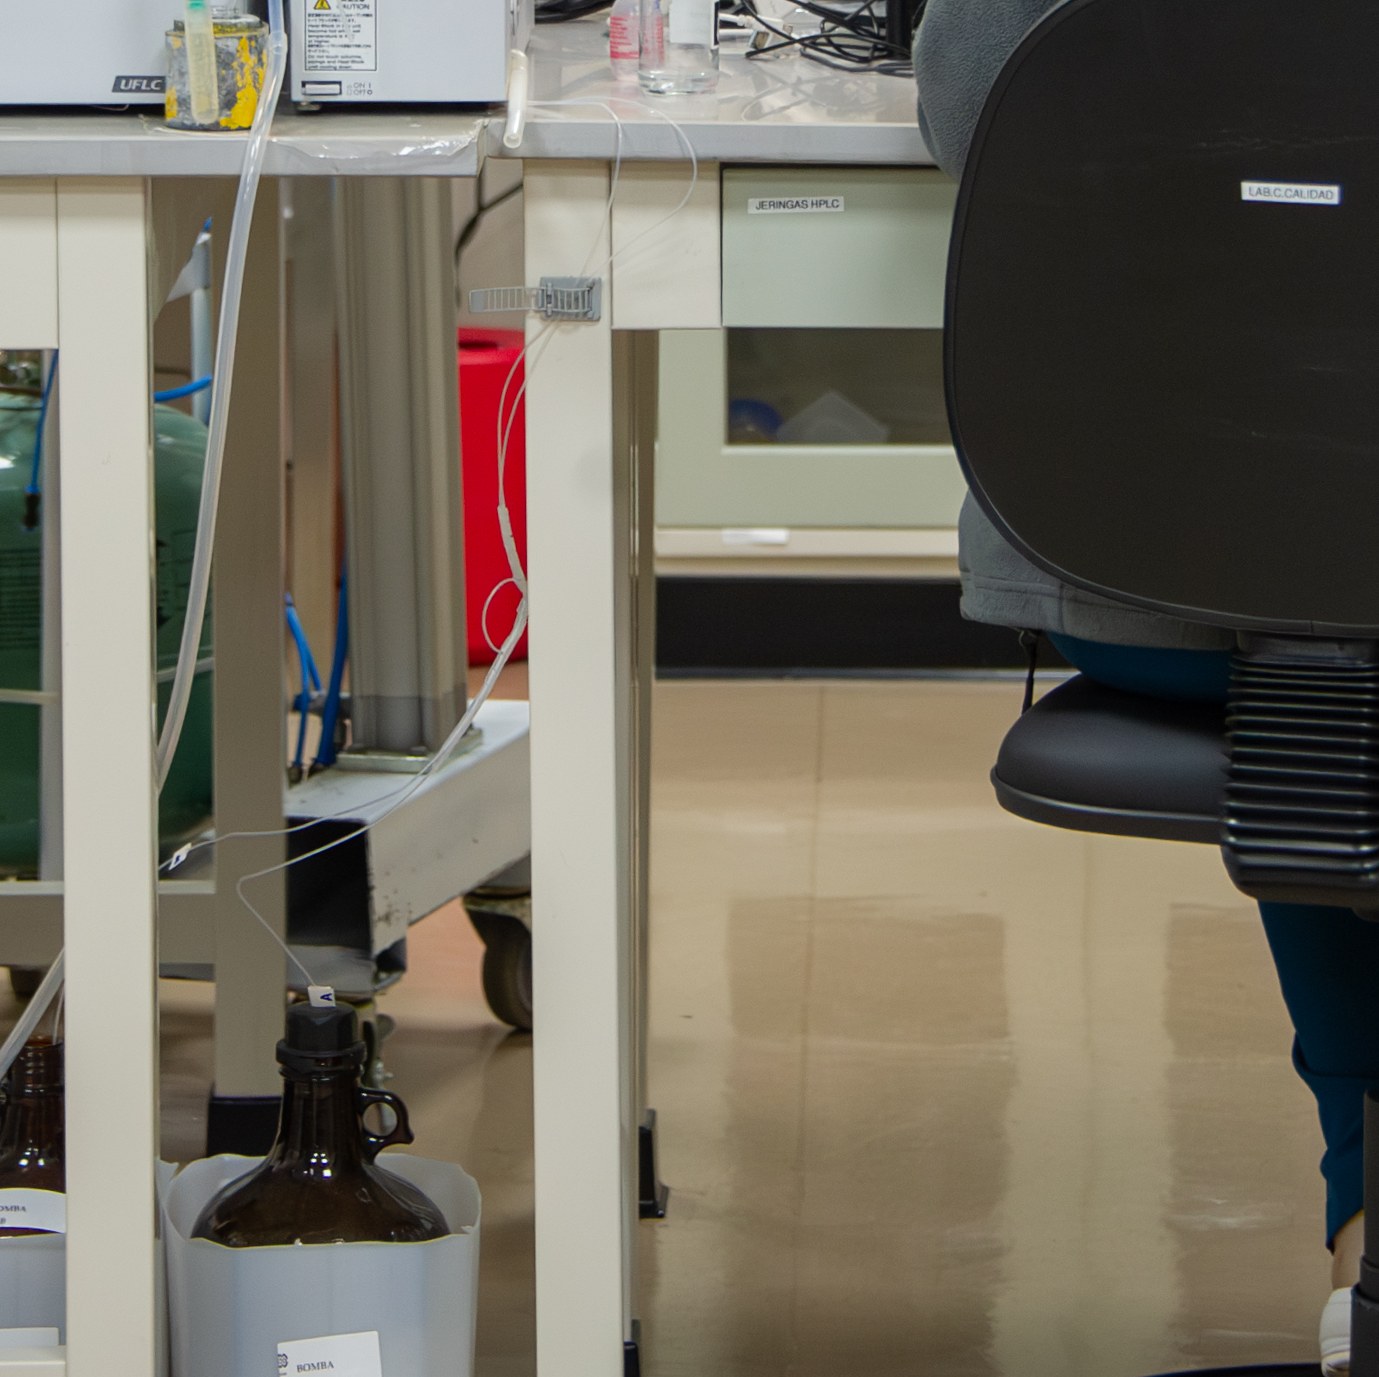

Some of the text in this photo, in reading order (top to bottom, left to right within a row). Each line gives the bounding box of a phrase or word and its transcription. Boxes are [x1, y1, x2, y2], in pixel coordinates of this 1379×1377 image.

[119, 78, 162, 91] UFLC
[1248, 186, 1333, 200] LAB.C.CALIDAD
[756, 198, 839, 210] JERINGAS HPLC
[320, 992, 333, 1002] A
[296, 1360, 335, 1373] BOMBA
